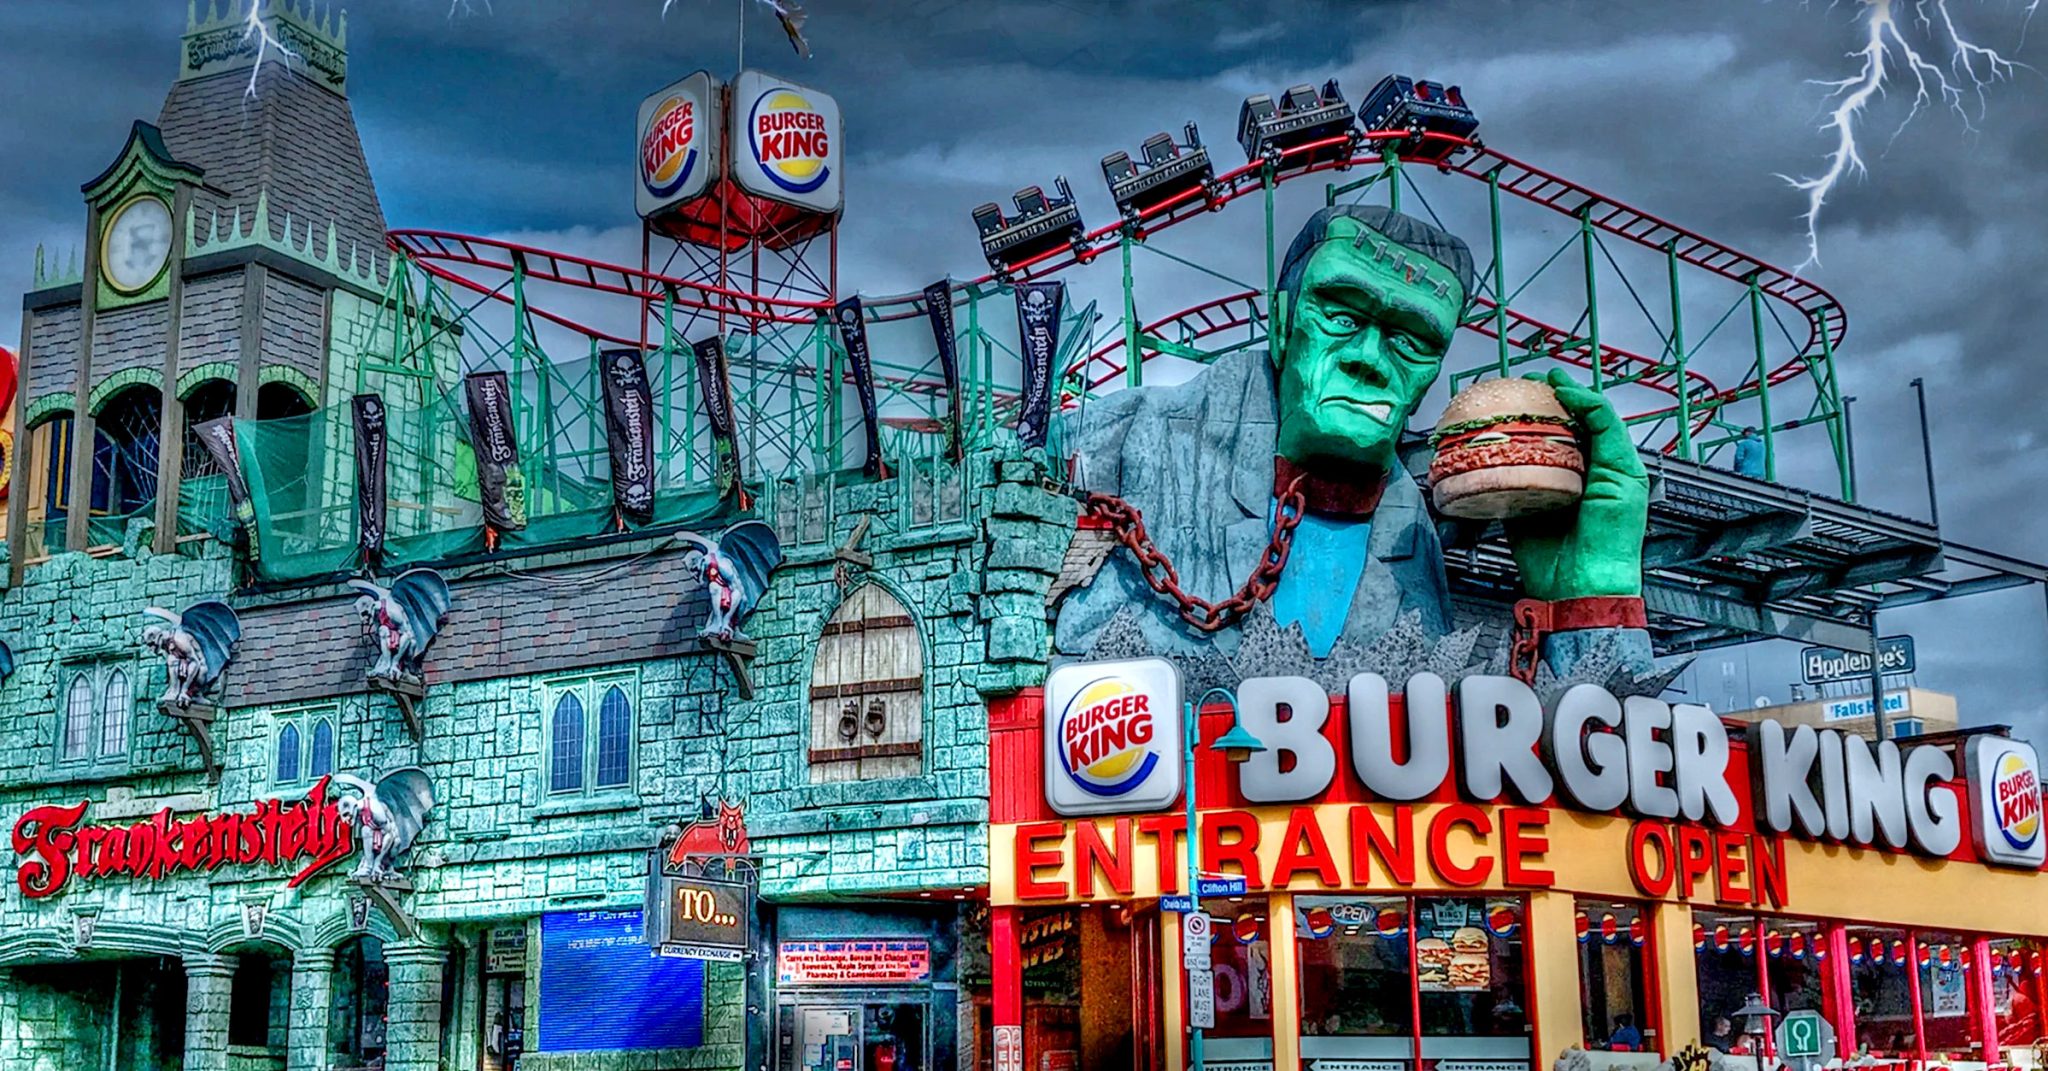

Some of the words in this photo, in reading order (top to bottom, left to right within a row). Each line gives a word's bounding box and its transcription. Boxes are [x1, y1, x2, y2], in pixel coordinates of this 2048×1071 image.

[643, 101, 694, 157] BURGER
[758, 111, 826, 134] BURGER
[644, 117, 694, 182] KING
[761, 131, 829, 162] KING
[620, 388, 648, 482] Frankenstein
[1066, 694, 1150, 744] BURGER
[1867, 695, 1902, 713] Htel
[1069, 714, 1154, 773] KING
[1236, 671, 1740, 827] BURGER
[1760, 718, 1962, 857] KING
[1999, 769, 2036, 802] BURGE
[2002, 789, 2040, 829] KING
[11, 774, 355, 898] Frankenstein
[1015, 804, 1556, 899] ENTRANCE
[1628, 819, 1790, 909] OPEN
[1201, 883, 1228, 894] Clifton
[1229, 882, 1243, 892] Hill
[678, 887, 736, 926] TO...
[1332, 903, 1372, 922] OPEN
[663, 945, 696, 956] CURRENCY
[697, 949, 731, 959] EXCHANGE
[1204, 1063, 1270, 1071] NTRANCE
[1320, 1063, 1402, 1071] ENTRANCE
[1444, 1063, 1527, 1071] ENTRANCE
